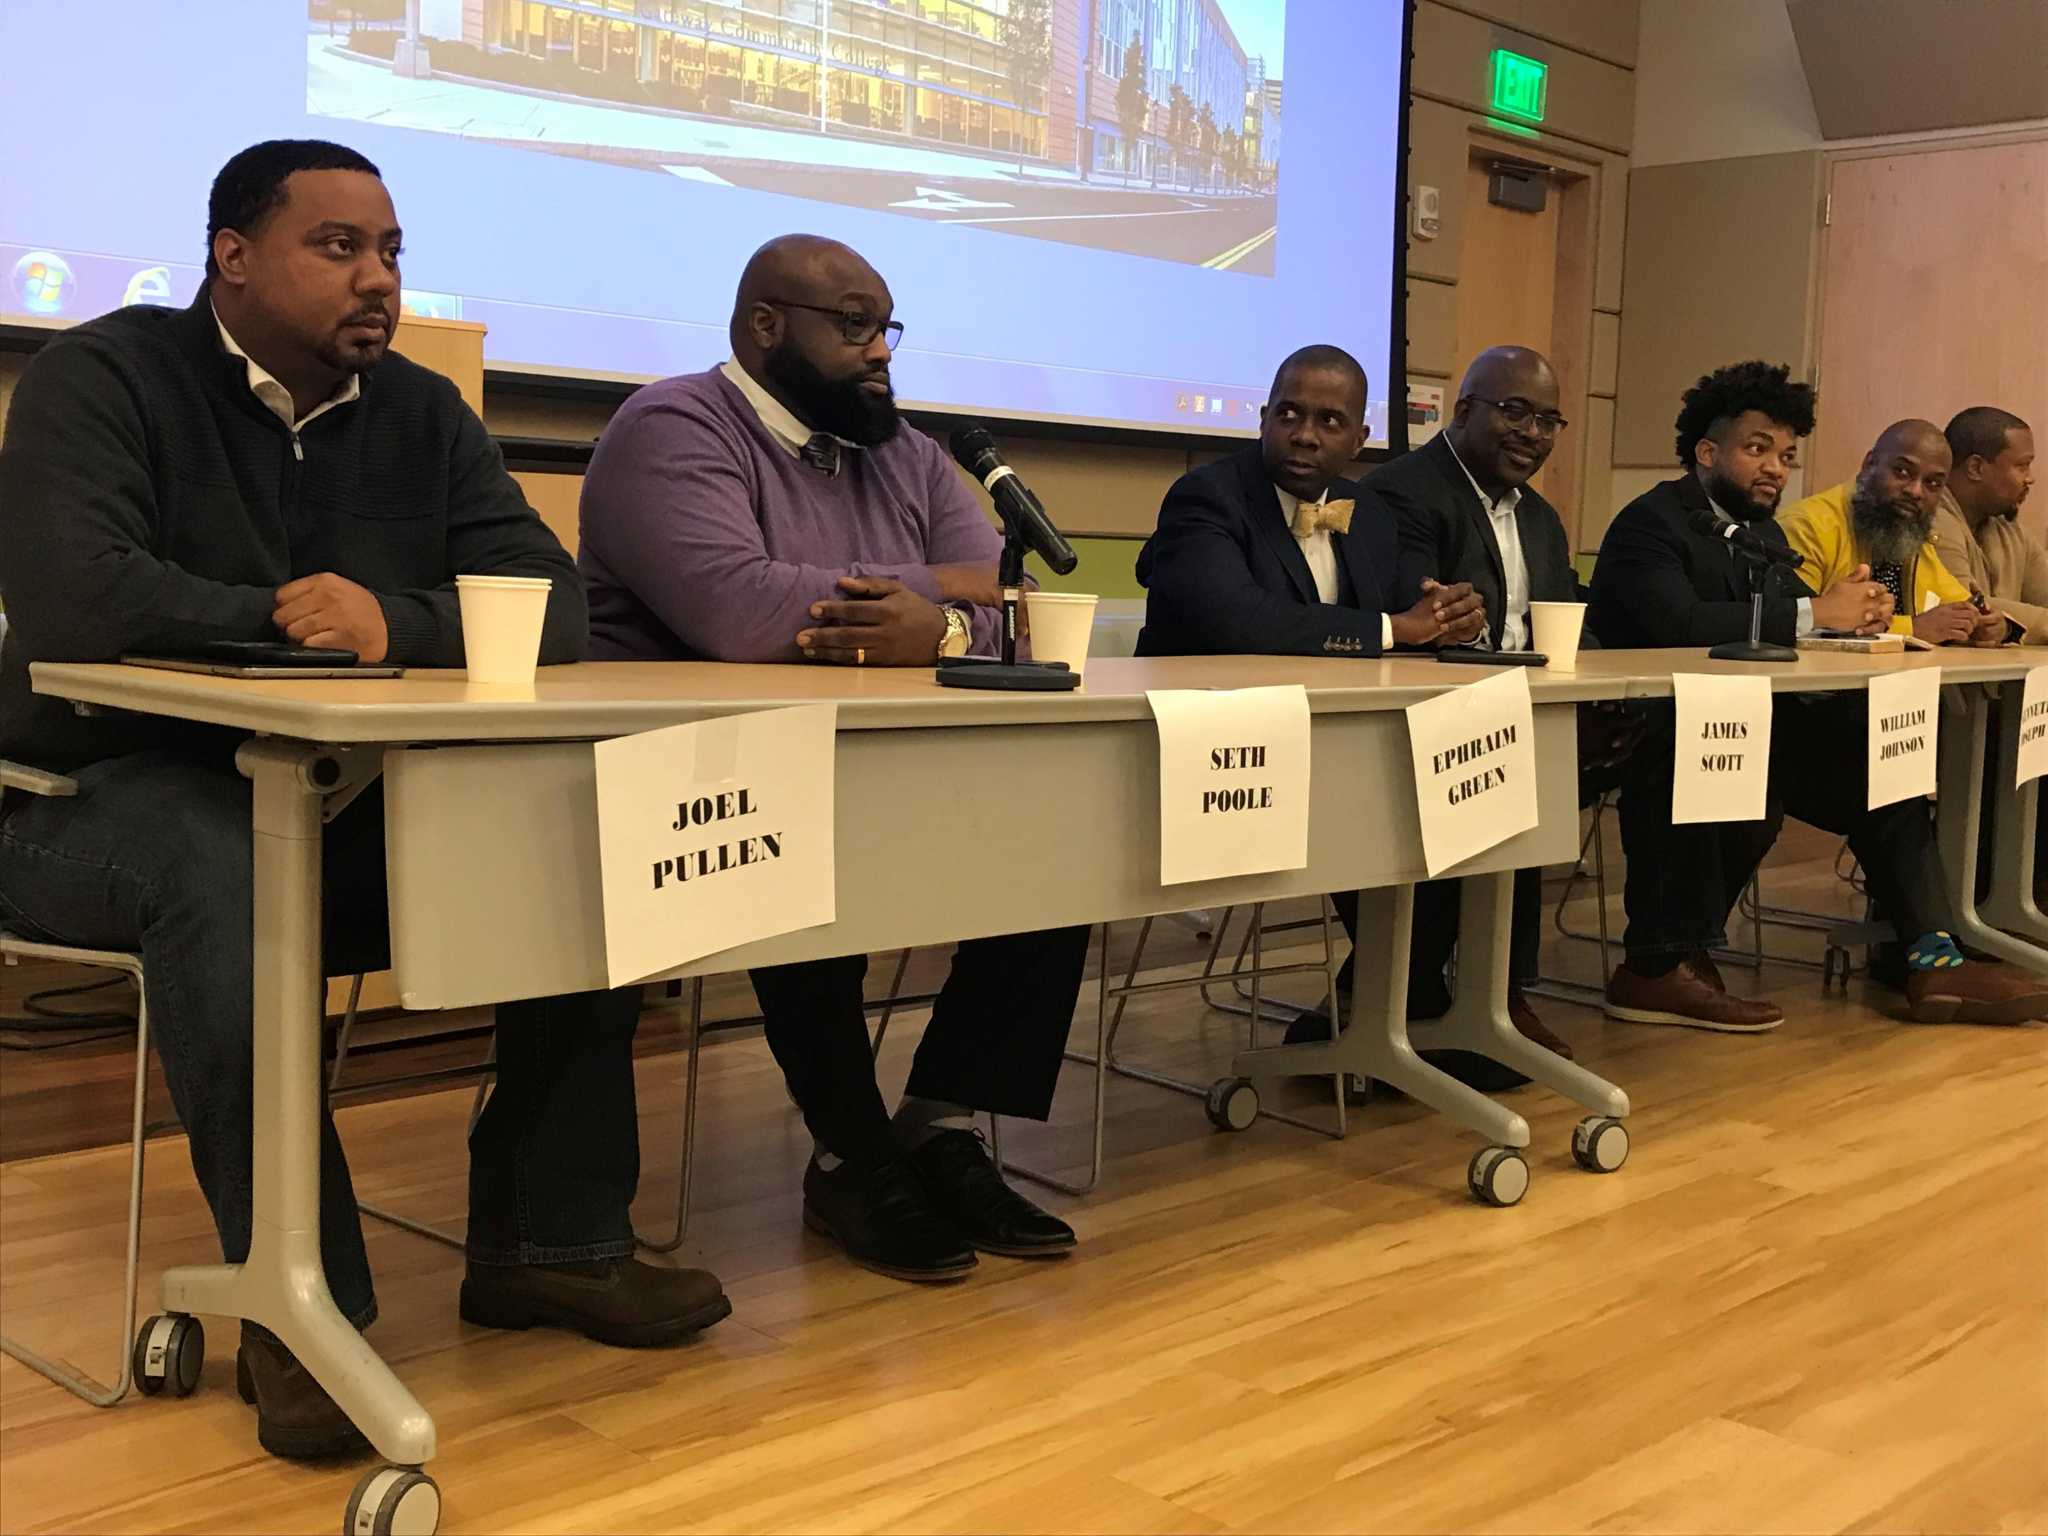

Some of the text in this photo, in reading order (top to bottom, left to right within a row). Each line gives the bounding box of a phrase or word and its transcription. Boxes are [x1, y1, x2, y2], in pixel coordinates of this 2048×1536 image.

[1503, 58, 1543, 112] EXIT
[1701, 721, 1749, 739] JAMES
[1880, 709, 1926, 733] WILLIAM
[1209, 745, 1267, 771] SETH
[1432, 724, 1517, 775] EPHRAIM
[1880, 735, 1926, 761] JOHNSON
[1700, 753, 1745, 772] SCOTT
[1447, 764, 1506, 806] GREEN
[672, 788, 757, 832] JOEL
[1202, 786, 1273, 814] POOLE
[651, 831, 783, 890] PULLEN
